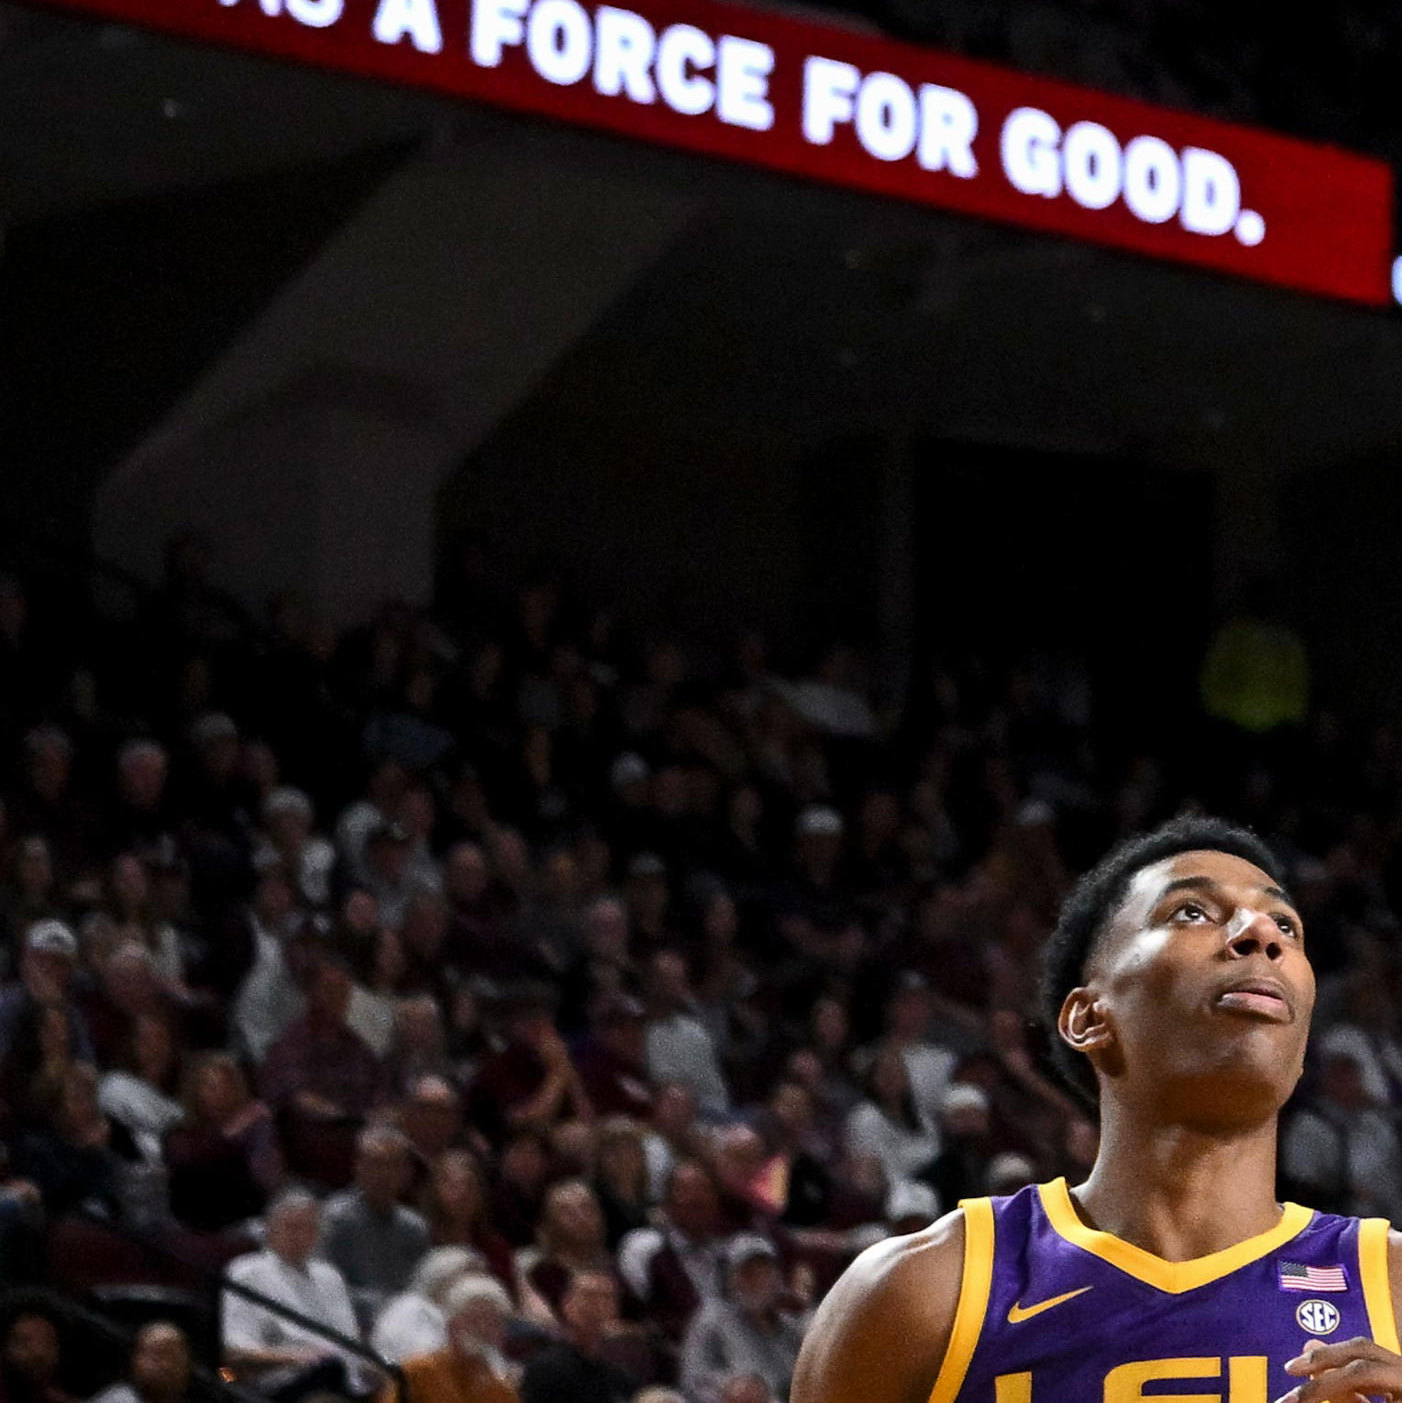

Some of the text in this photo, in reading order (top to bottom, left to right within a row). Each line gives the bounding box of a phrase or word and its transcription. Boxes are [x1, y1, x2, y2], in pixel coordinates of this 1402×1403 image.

[802, 54, 979, 179] FOR
[1000, 106, 1266, 247] GOOD.
[1300, 1301, 1337, 1333] SEC
